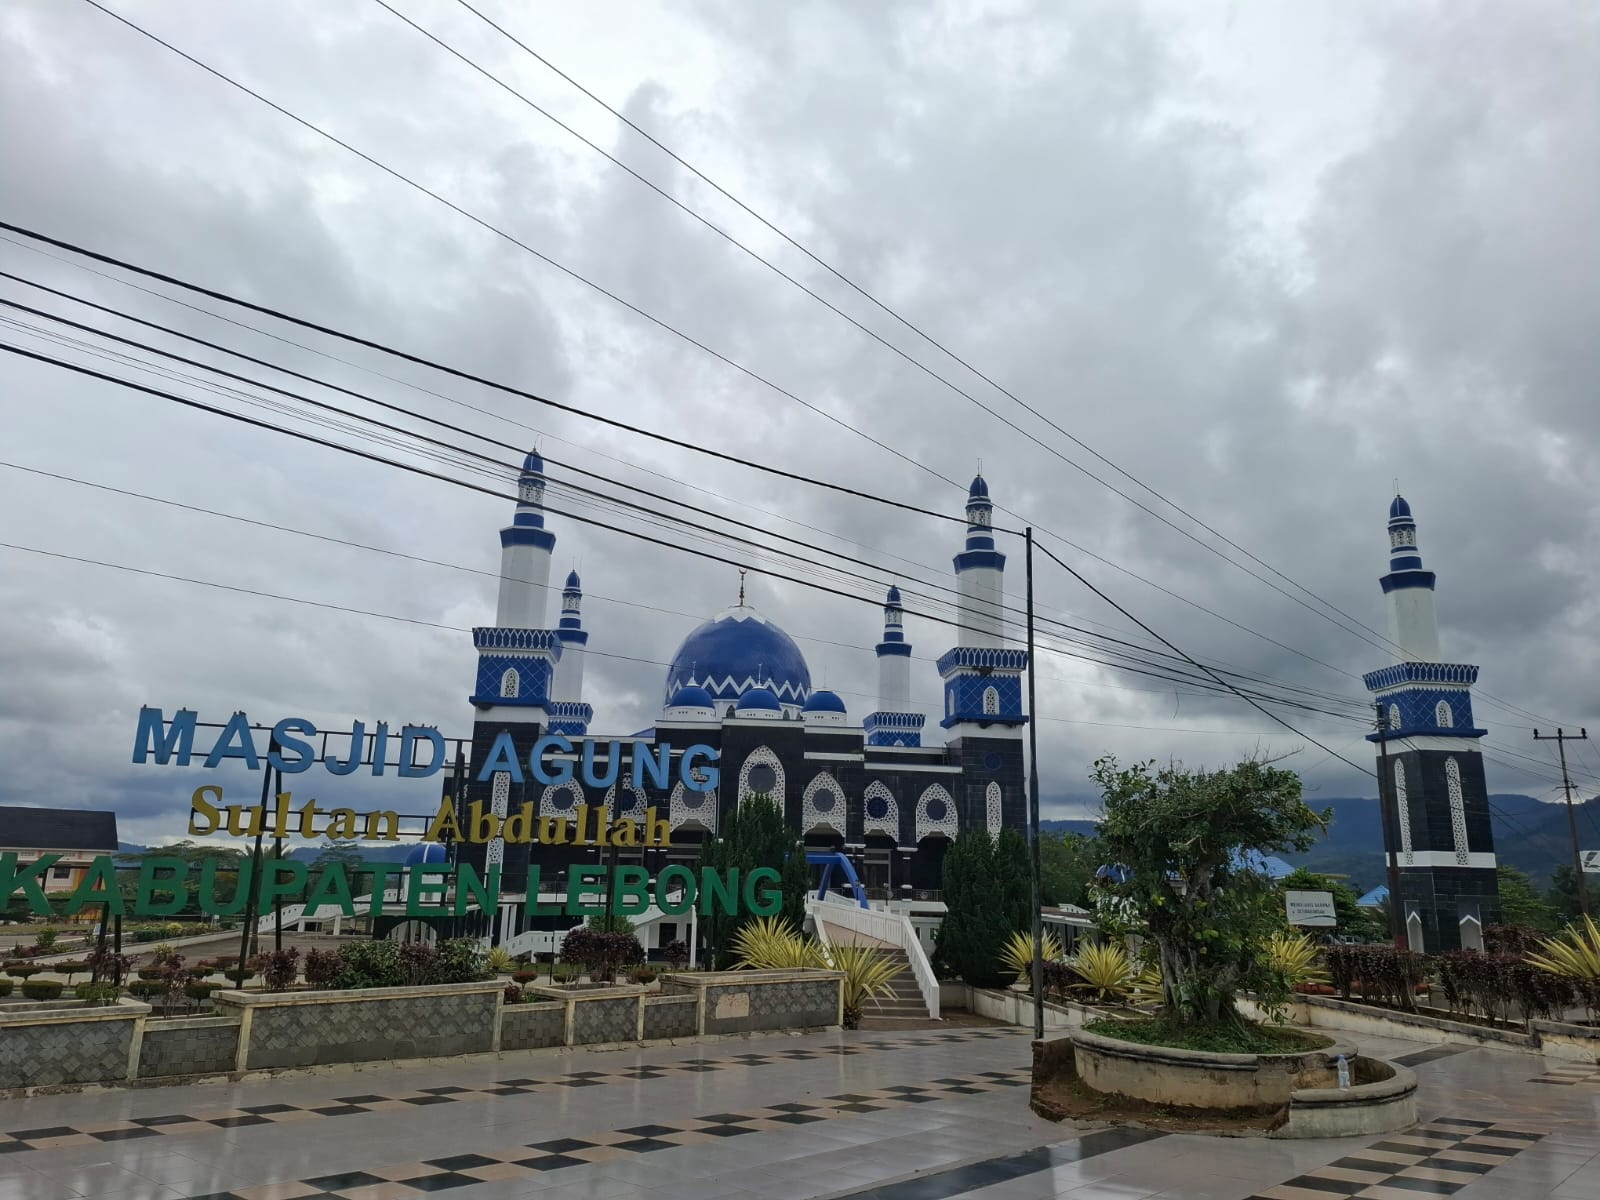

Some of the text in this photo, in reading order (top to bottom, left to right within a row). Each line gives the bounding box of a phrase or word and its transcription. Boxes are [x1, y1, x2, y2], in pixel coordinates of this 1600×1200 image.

[133, 706, 720, 792] MASJID AGUNG
[188, 785, 673, 847] Sultan Abdullah
[0, 852, 784, 917] KABUPATEN LEBONG
